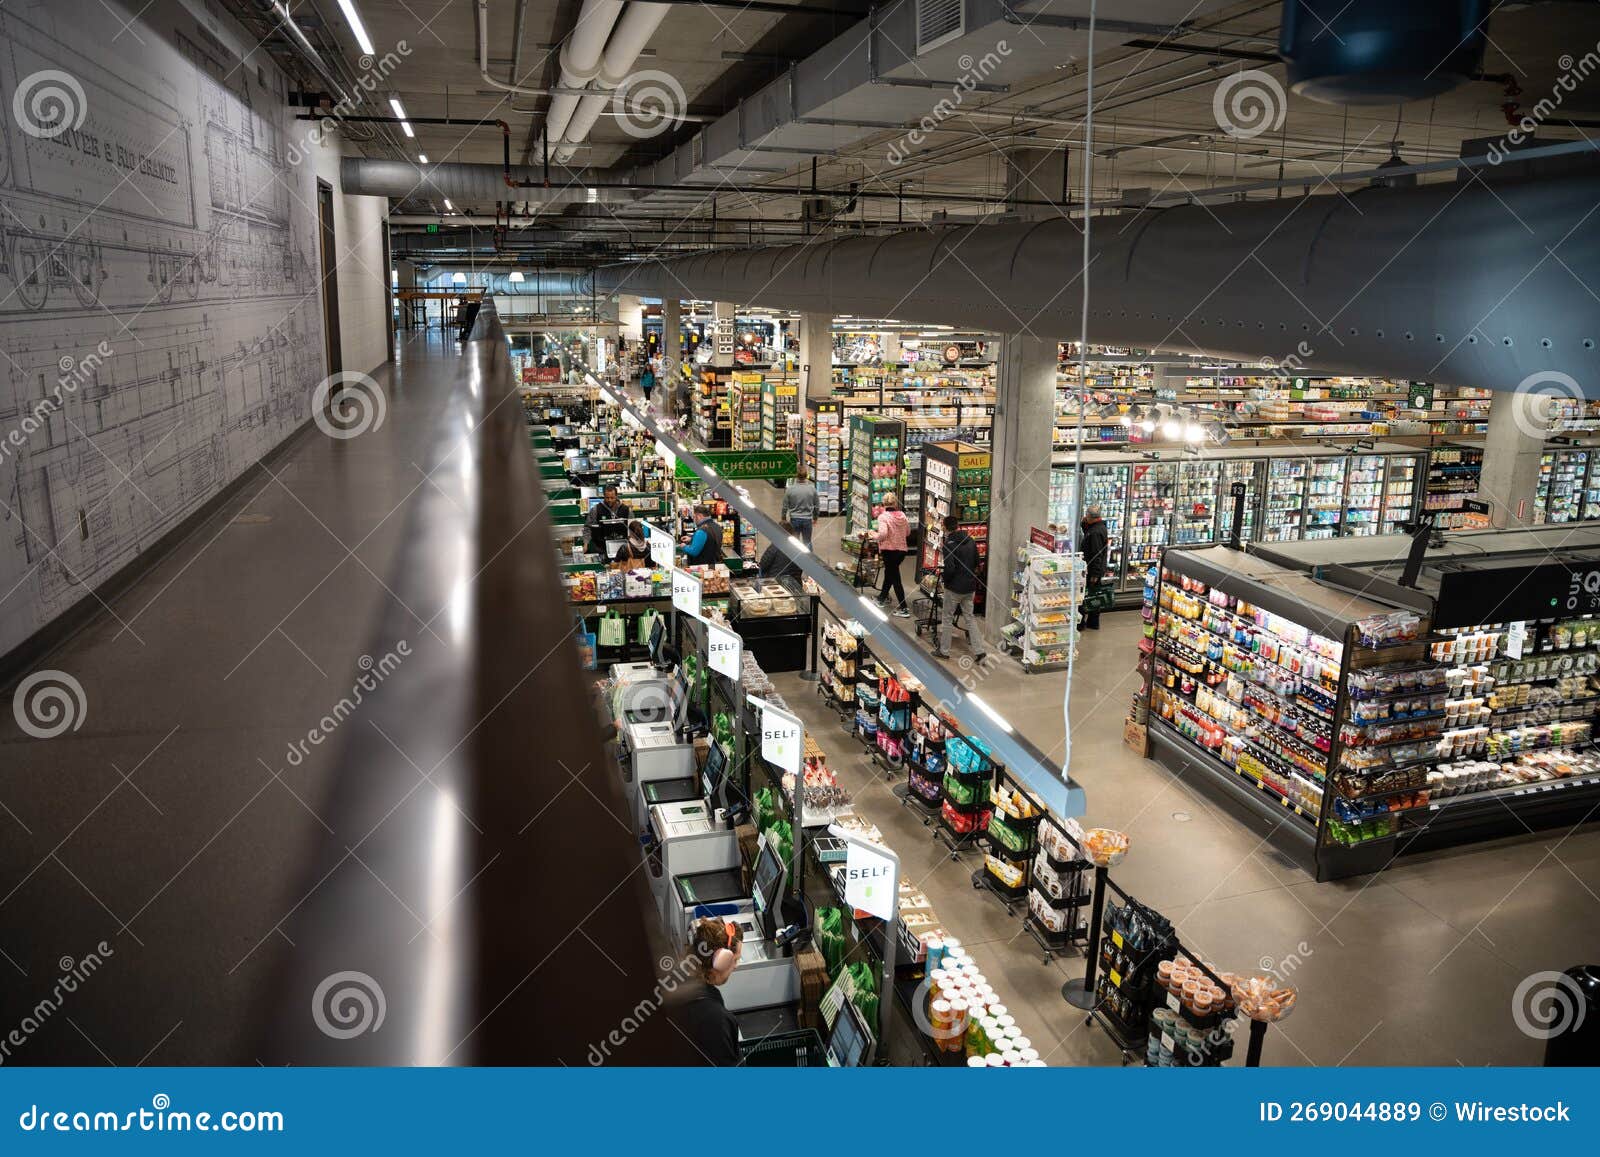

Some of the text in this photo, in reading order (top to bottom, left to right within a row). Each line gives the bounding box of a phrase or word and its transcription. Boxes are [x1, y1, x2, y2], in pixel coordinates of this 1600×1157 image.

[719, 317, 734, 354] BEER
[722, 460, 783, 471] CHECKOUT
[963, 458, 985, 466] SALE
[1232, 486, 1244, 495] 13
[1419, 514, 1433, 525] 14
[674, 585, 697, 593] SELF
[1566, 571, 1583, 610] OUR
[710, 642, 737, 652] SELF
[764, 729, 797, 740] SELF
[850, 866, 891, 880] SELF
